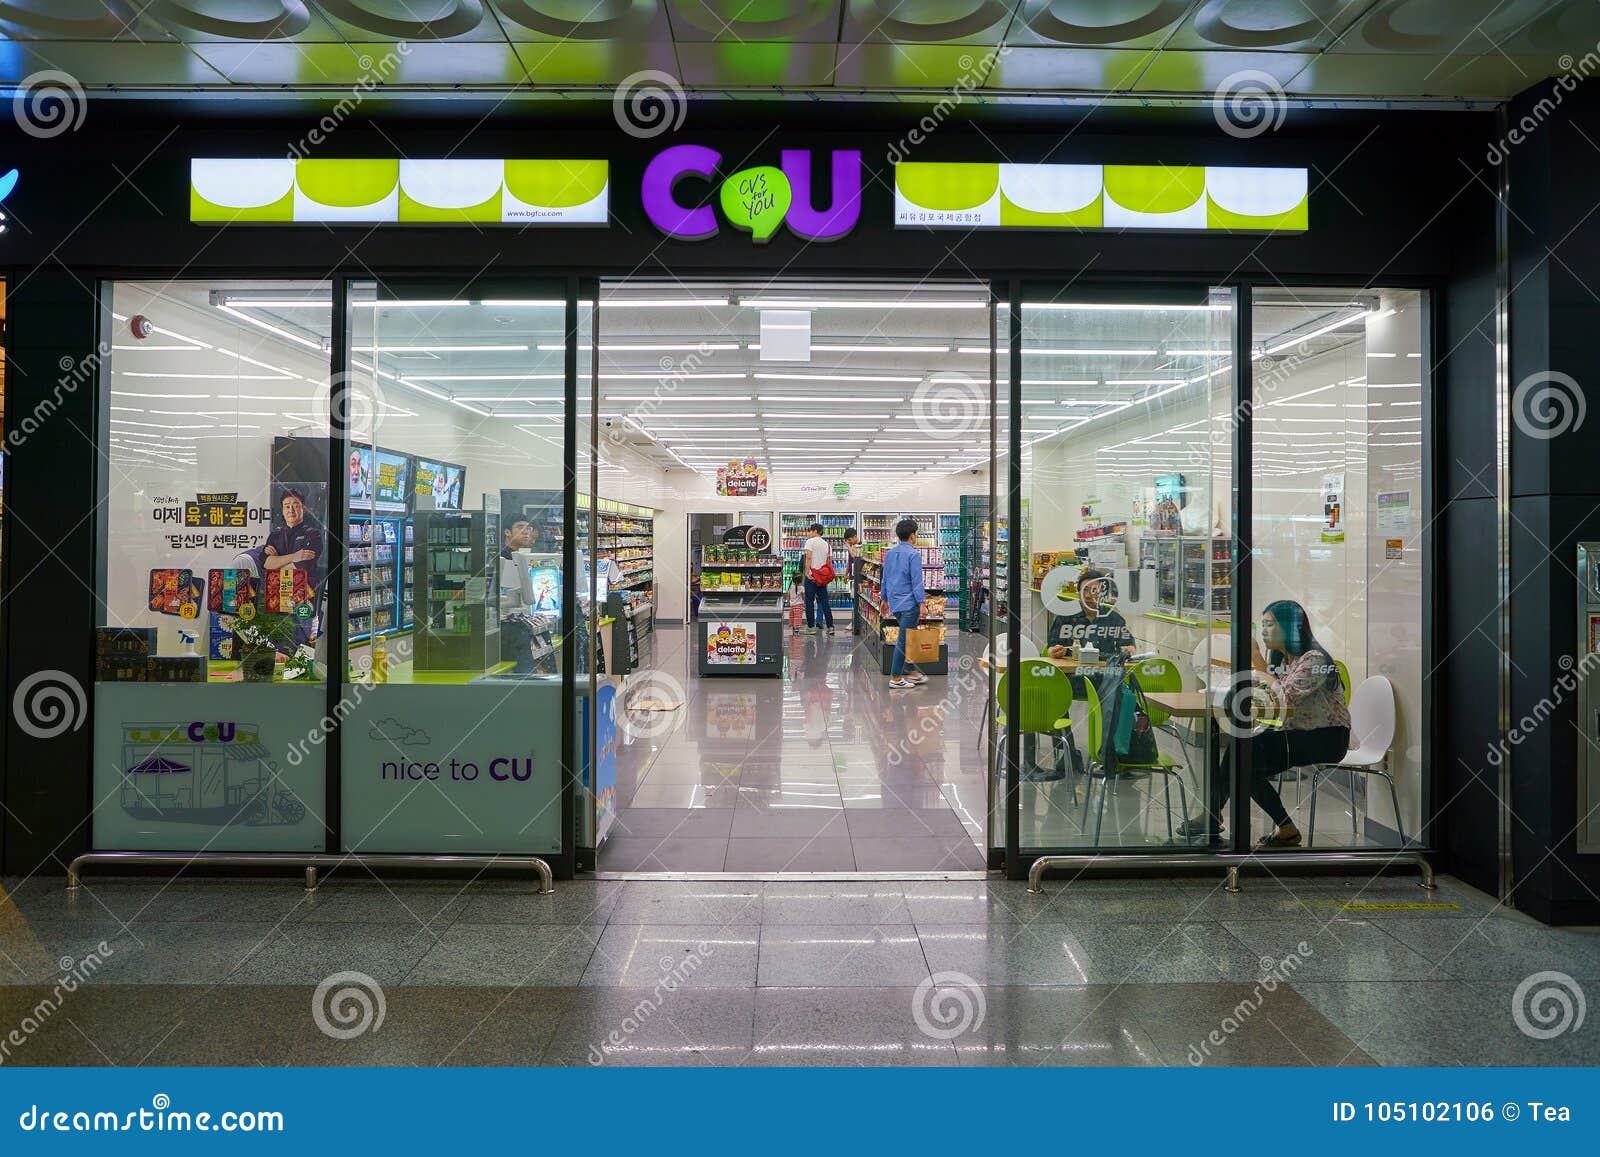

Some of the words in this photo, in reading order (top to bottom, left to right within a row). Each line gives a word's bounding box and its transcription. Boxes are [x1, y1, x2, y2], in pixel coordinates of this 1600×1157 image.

[739, 173, 766, 195] CVS
[507, 210, 563, 218] www.bgfcu.com
[743, 193, 775, 220] YOU
[727, 479, 757, 488] delaffe
[152, 507, 182, 524] 이제
[165, 534, 208, 549] "당신의
[212, 534, 264, 549] 선택은?"
[1059, 624, 1131, 639] BGF리테일
[382, 756, 440, 781] nice
[450, 758, 479, 781] to
[489, 757, 533, 782] CU
